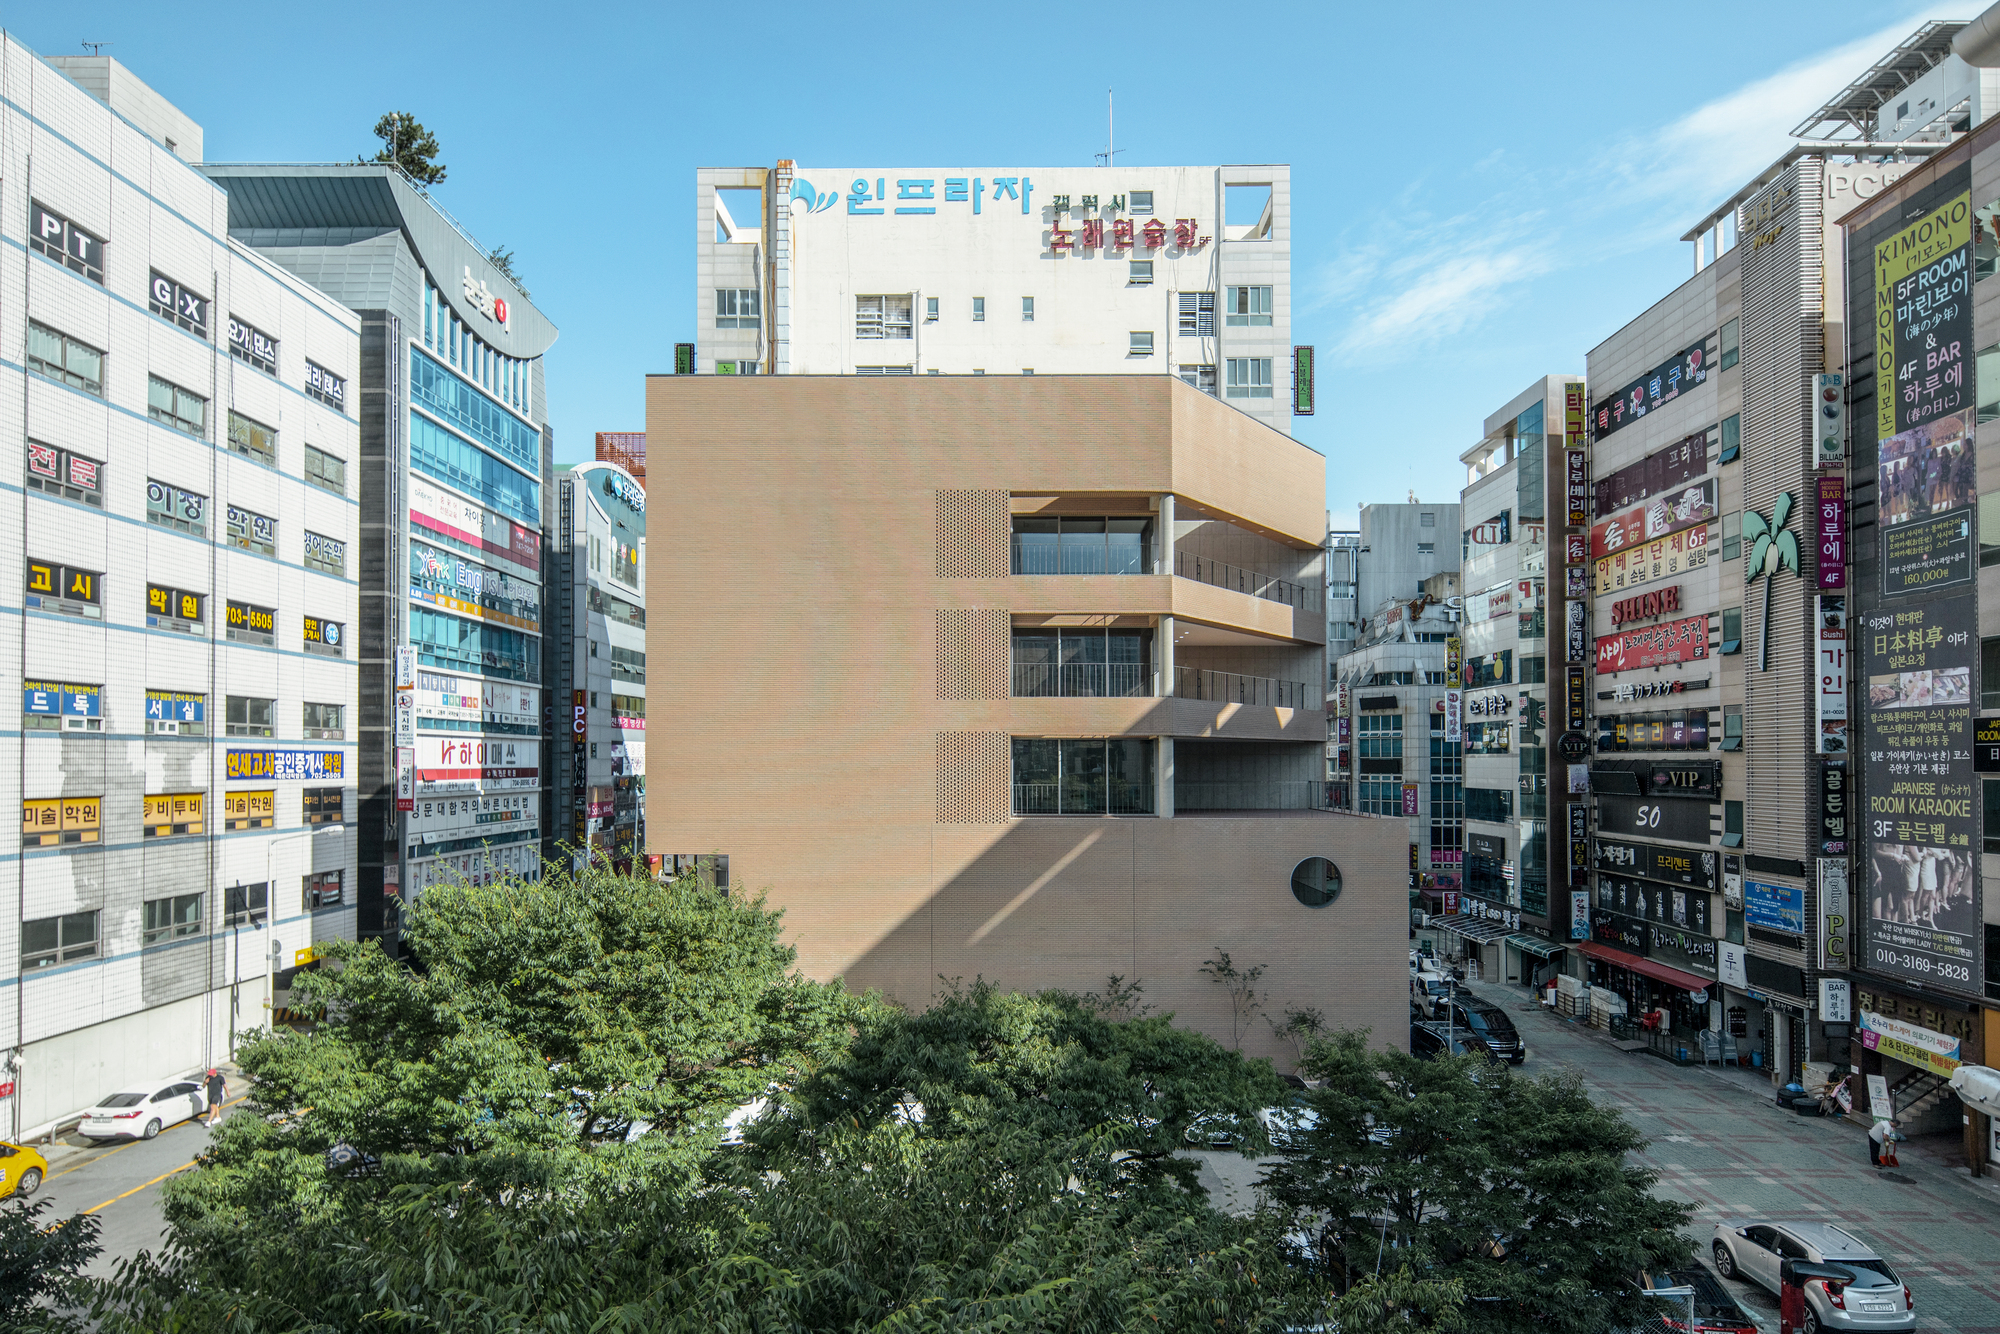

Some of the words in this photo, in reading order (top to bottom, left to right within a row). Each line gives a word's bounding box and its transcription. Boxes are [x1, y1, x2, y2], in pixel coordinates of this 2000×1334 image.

[846, 176, 1035, 216] 윈프라자
[41, 212, 91, 259] PT
[1051, 218, 1198, 249] 노래연습장
[1199, 236, 1213, 245] 5F
[1878, 201, 1967, 267] KIMONO
[1906, 233, 1952, 272] (기모노)
[1897, 276, 1917, 301] 5F
[1919, 249, 1966, 290] ROOM
[1897, 270, 1968, 325] 마린보이
[1905, 303, 1959, 341] (海の少年)
[1925, 333, 1937, 350] &
[1898, 359, 1918, 381] 4F
[1926, 340, 1961, 372] BAR
[1820, 374, 1842, 386] J&B
[1903, 361, 1963, 405] 하루에
[1598, 399, 1625, 429] 탁구
[1649, 365, 1682, 399] 탁구
[1880, 374, 1893, 433] (기모노)
[1906, 391, 1960, 425] (春の日に)
[1566, 392, 1584, 444] 탁구
[1819, 453, 1844, 462] BILLIAD
[1570, 454, 1584, 511] 블루베리
[1821, 490, 1842, 499] BAR
[622, 482, 645, 512] 우리은행
[1652, 502, 1665, 531] 톰
[1666, 502, 1675, 524] &
[1677, 486, 1705, 518] 제리
[1702, 507, 1711, 518] 6F
[227, 507, 273, 542] 학원
[464, 506, 486, 533] 차이홍
[1821, 502, 1842, 562] 하루에
[1603, 520, 1625, 552] 솜
[1629, 530, 1640, 543] 6F
[1936, 540, 1949, 549] 스시
[1598, 548, 1645, 576] 아베크
[1650, 534, 1683, 561] 단체
[1689, 529, 1706, 548] 6F
[455, 561, 505, 598] English
[1602, 573, 1625, 592] 노래
[1630, 566, 1646, 584] 손님
[1652, 557, 1678, 578] 환영
[1825, 573, 1839, 583] 4F
[1903, 568, 1950, 585] 160,000원
[30, 565, 92, 601] 고시
[150, 588, 198, 619] 학원
[1611, 585, 1679, 626] SHINE
[1869, 615, 1893, 630] 이것이
[1895, 611, 1924, 627] 현대판
[1822, 630, 1843, 639] Sushi
[1873, 625, 1944, 657] 日本料亭
[1947, 631, 1969, 647] 이다
[1599, 637, 1625, 667] 샤인
[1694, 647, 1703, 657] 5F
[1888, 652, 1926, 669] 일본요정
[1821, 648, 1844, 695] 가인
[1570, 677, 1583, 718] 판도라
[1635, 680, 1673, 699] カラオケ
[1470, 694, 1507, 716] 노래타운
[1929, 708, 1946, 721] 스시,
[1947, 707, 1970, 720] 사시미
[573, 706, 586, 733] PC
[1572, 719, 1582, 727] 4F
[1615, 721, 1665, 744] 판도라
[1948, 721, 1963, 733] 과일
[1564, 742, 1588, 752] VIP
[1673, 730, 1682, 741] 4F
[1924, 735, 1940, 747] 우동
[1941, 735, 1950, 747] 등
[1870, 751, 1884, 762] 일본
[1952, 750, 1971, 760] 코스
[1888, 763, 1911, 775] 주안상
[1912, 763, 1928, 775] 기본
[1930, 763, 1950, 775] 제공!
[401, 767, 410, 795] 차이홍
[1669, 771, 1699, 787] VIP
[1891, 782, 1936, 796] JAPANESE
[24, 805, 57, 826] 미술
[65, 803, 96, 824] 학원
[157, 800, 201, 817] 비투비
[225, 799, 247, 813] 미술
[250, 796, 272, 811] 학원
[449, 799, 479, 815] 합격의
[483, 798, 500, 811] 바른
[503, 796, 528, 810] 대비법
[1825, 770, 1845, 836] 골든벨
[1871, 796, 1905, 814] ROOM
[1909, 797, 1971, 818] KARAOKE
[1635, 805, 1661, 829] SO
[1873, 820, 1893, 838] 3F
[1896, 821, 1946, 844] 골든벨
[1602, 845, 1636, 866] 자전거
[1827, 842, 1843, 852] 3F
[1831, 879, 1840, 914] gallery
[1695, 899, 1705, 925] 작업
[1650, 927, 1679, 949] 김가네
[1683, 937, 1715, 964] 빈대떡
[1827, 914, 1845, 956] PC
[1916, 939, 1932, 949] LADY
[1724, 951, 1737, 971] 루
[1876, 948, 1970, 982] 010-3169-5828
[1828, 983, 1846, 991] BAR
[1829, 993, 1839, 1020] 하루에
[1912, 1030, 1936, 1045] 의료기기
[1902, 1044, 1929, 1062] 당구클럽
